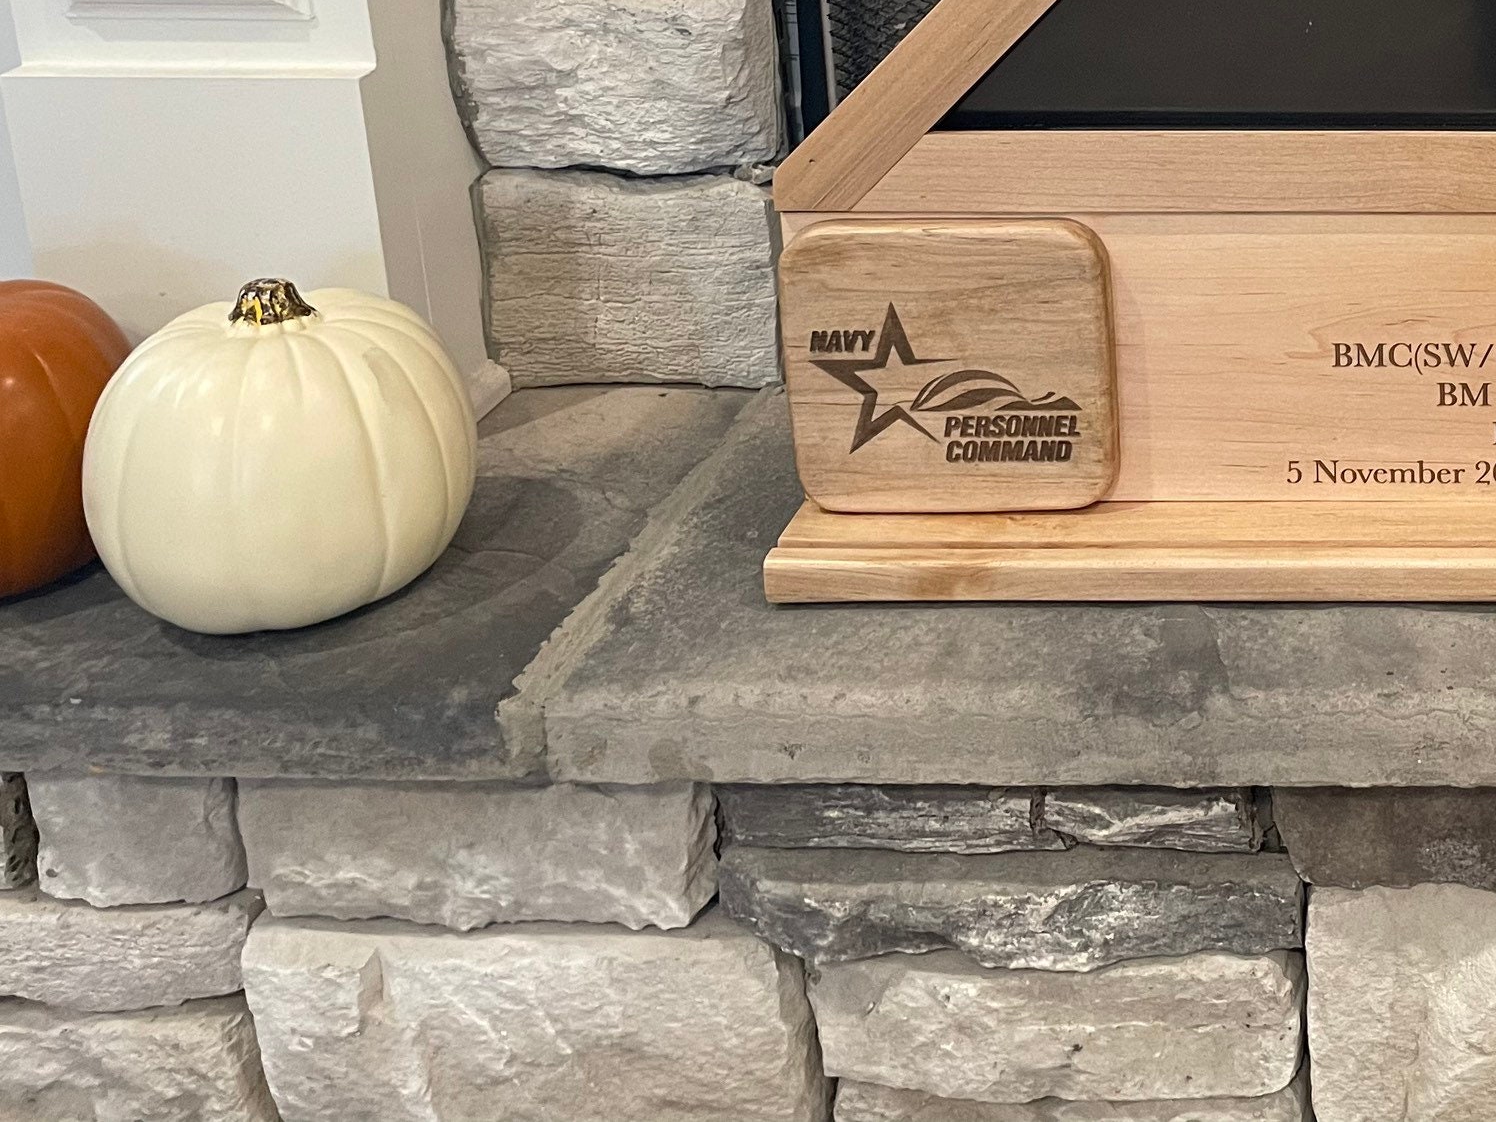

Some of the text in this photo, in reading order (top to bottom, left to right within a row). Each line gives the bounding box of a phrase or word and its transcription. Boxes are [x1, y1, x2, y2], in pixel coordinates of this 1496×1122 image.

[810, 330, 876, 353] NAVY
[1436, 382, 1490, 407] BM
[944, 414, 1082, 438] PERSONNEL
[945, 440, 1073, 463] COMMAND
[1286, 461, 1304, 484] 5
[1312, 461, 1467, 485] November
